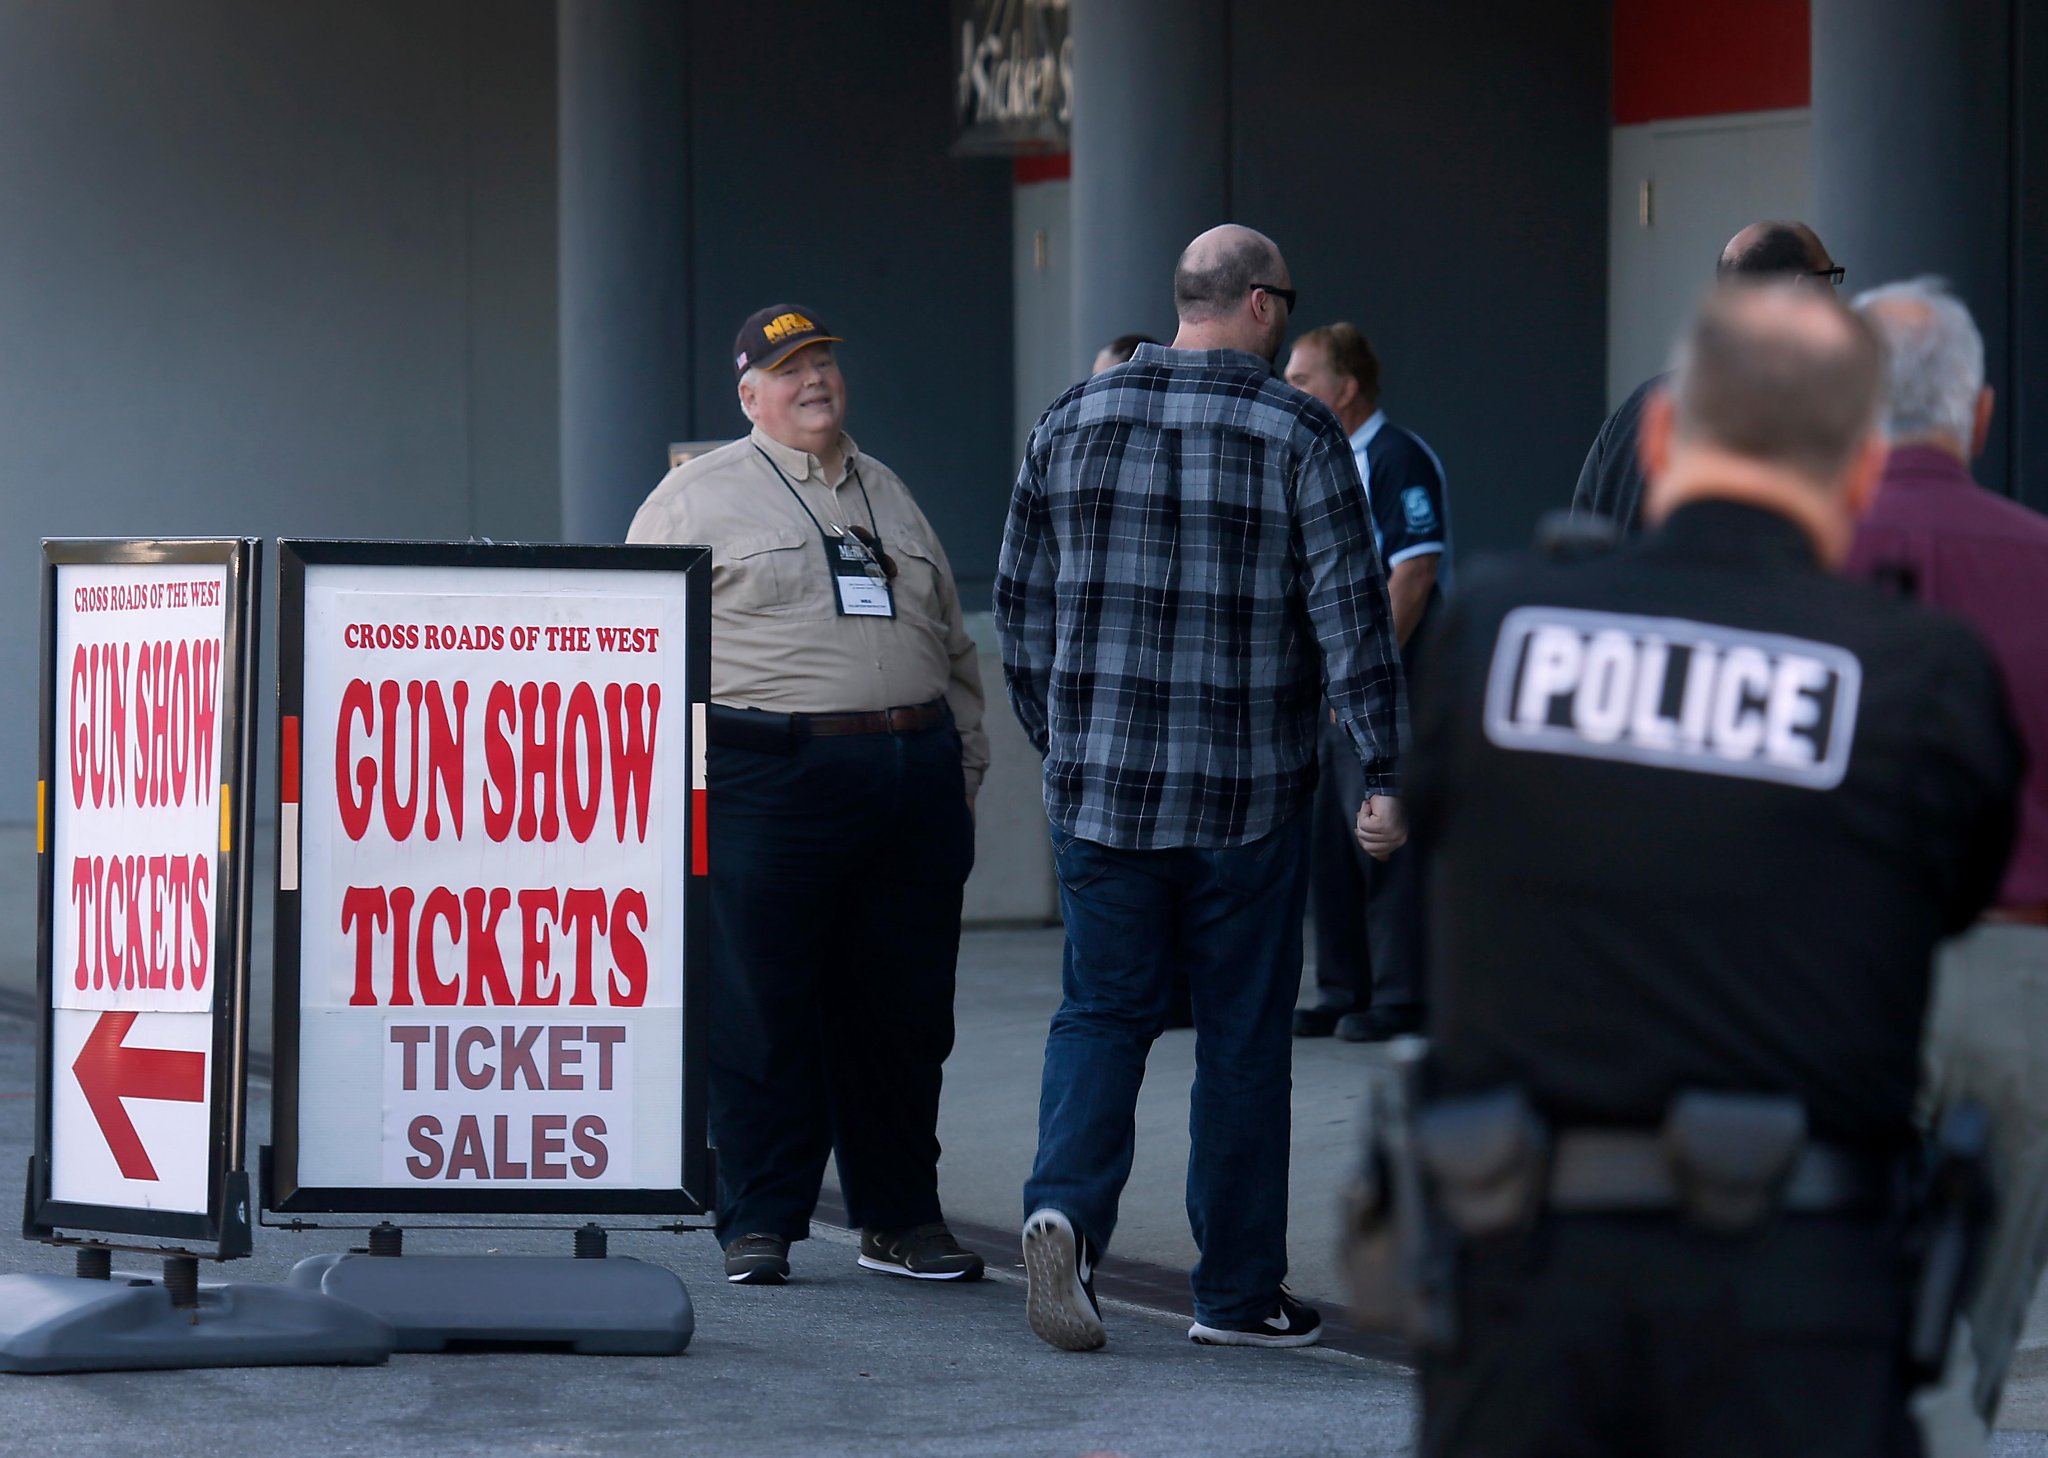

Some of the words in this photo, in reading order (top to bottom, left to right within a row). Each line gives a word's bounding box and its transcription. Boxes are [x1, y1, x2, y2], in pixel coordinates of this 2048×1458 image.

[763, 312, 815, 344] NRA
[74, 586, 109, 612] CROSS
[110, 584, 148, 611] ROADS
[150, 583, 165, 609] OF
[167, 582, 189, 608] THE
[190, 580, 221, 607] WEST
[343, 623, 420, 650] CROSS
[423, 625, 505, 650] ROADS
[509, 626, 541, 651] OF
[544, 627, 592, 652] THE
[595, 627, 660, 653] WEST
[69, 642, 130, 810] GUN
[133, 637, 221, 808] SHOW
[1513, 622, 1830, 772] POLICE
[335, 677, 469, 843] GUN
[482, 679, 662, 844] SHOW
[71, 853, 210, 993] TICKETS
[340, 884, 650, 1007] TICKETS
[389, 1024, 627, 1092] TICKET
[405, 1113, 609, 1182] SALES
